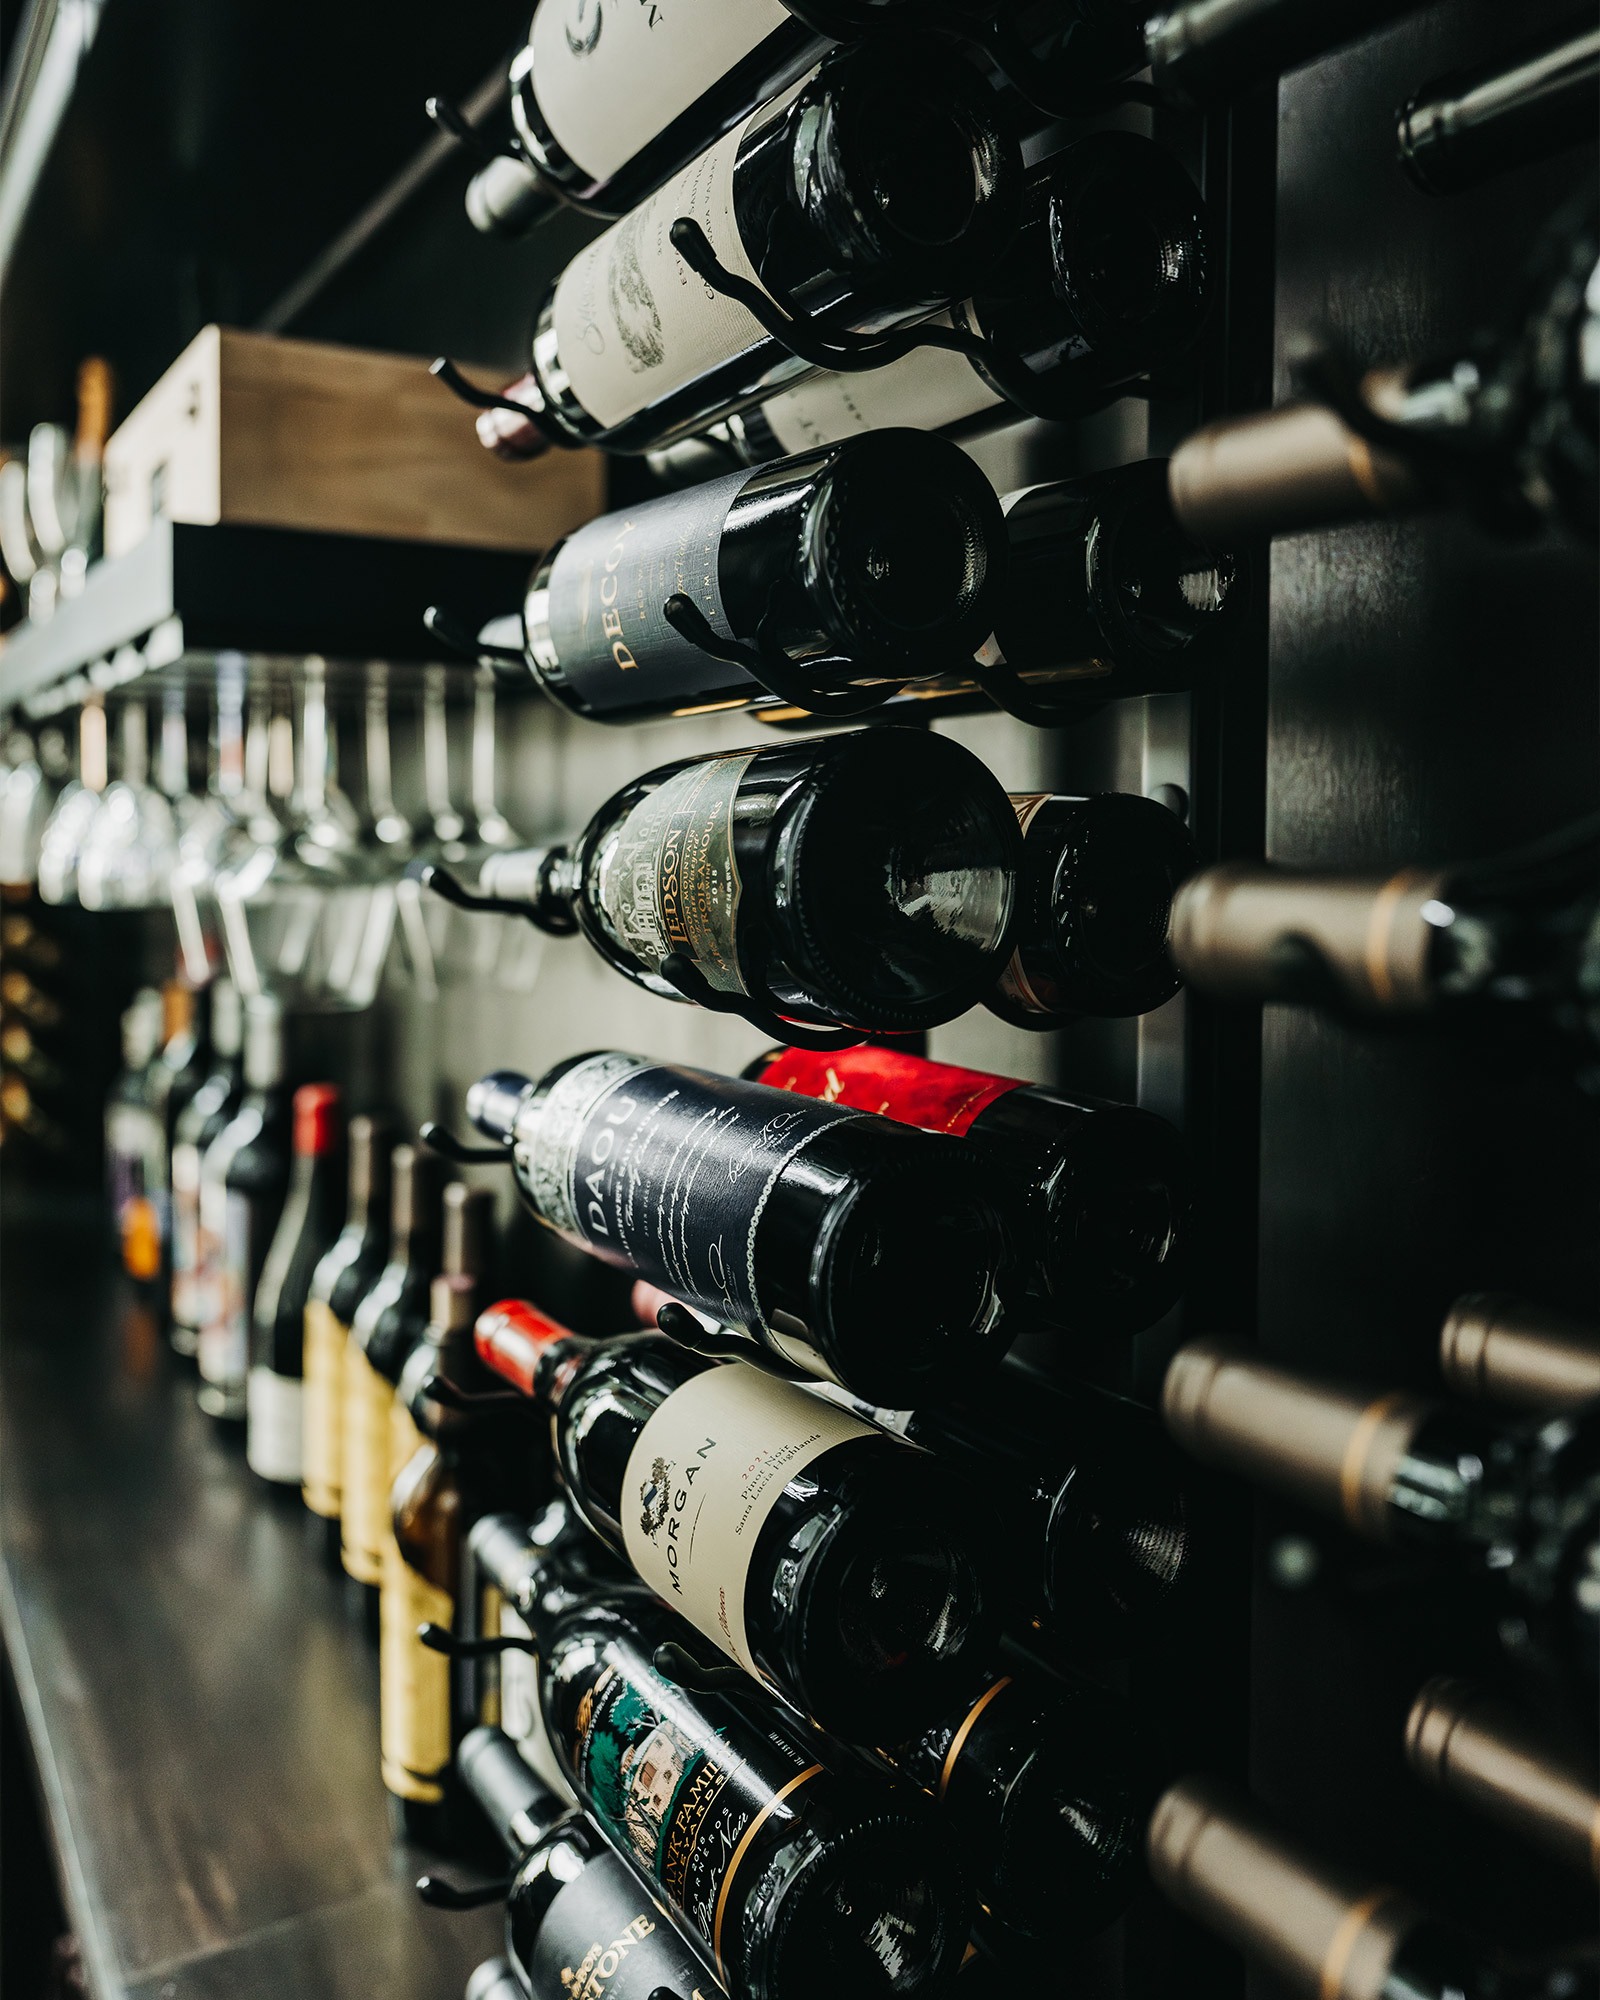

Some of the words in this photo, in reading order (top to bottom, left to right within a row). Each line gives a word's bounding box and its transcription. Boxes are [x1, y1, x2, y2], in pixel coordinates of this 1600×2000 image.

[601, 521, 639, 670] DECOY
[677, 573, 688, 595] pa
[683, 829, 696, 900] MOUNTAIN
[697, 800, 724, 877] AMOURS
[662, 829, 692, 945] LEDSON
[697, 881, 712, 935] TROIS
[711, 869, 719, 905] 2018
[685, 906, 699, 944] MOON
[585, 1095, 637, 1236] DAOU
[735, 1504, 753, 1536] Santa
[751, 1472, 774, 1502] Lucia
[773, 1433, 821, 1471] Highlands
[741, 1450, 769, 1481] 2021
[741, 1466, 763, 1500] Pinot
[764, 1444, 792, 1468] Noir
[667, 1437, 717, 1595] MORGAN
[665, 1831, 682, 1899] ANK
[692, 1836, 706, 1872] 2018
[693, 1807, 730, 1915] CARNEROS
[697, 1867, 718, 1947] Pinot
[718, 1811, 749, 1874] Noir
